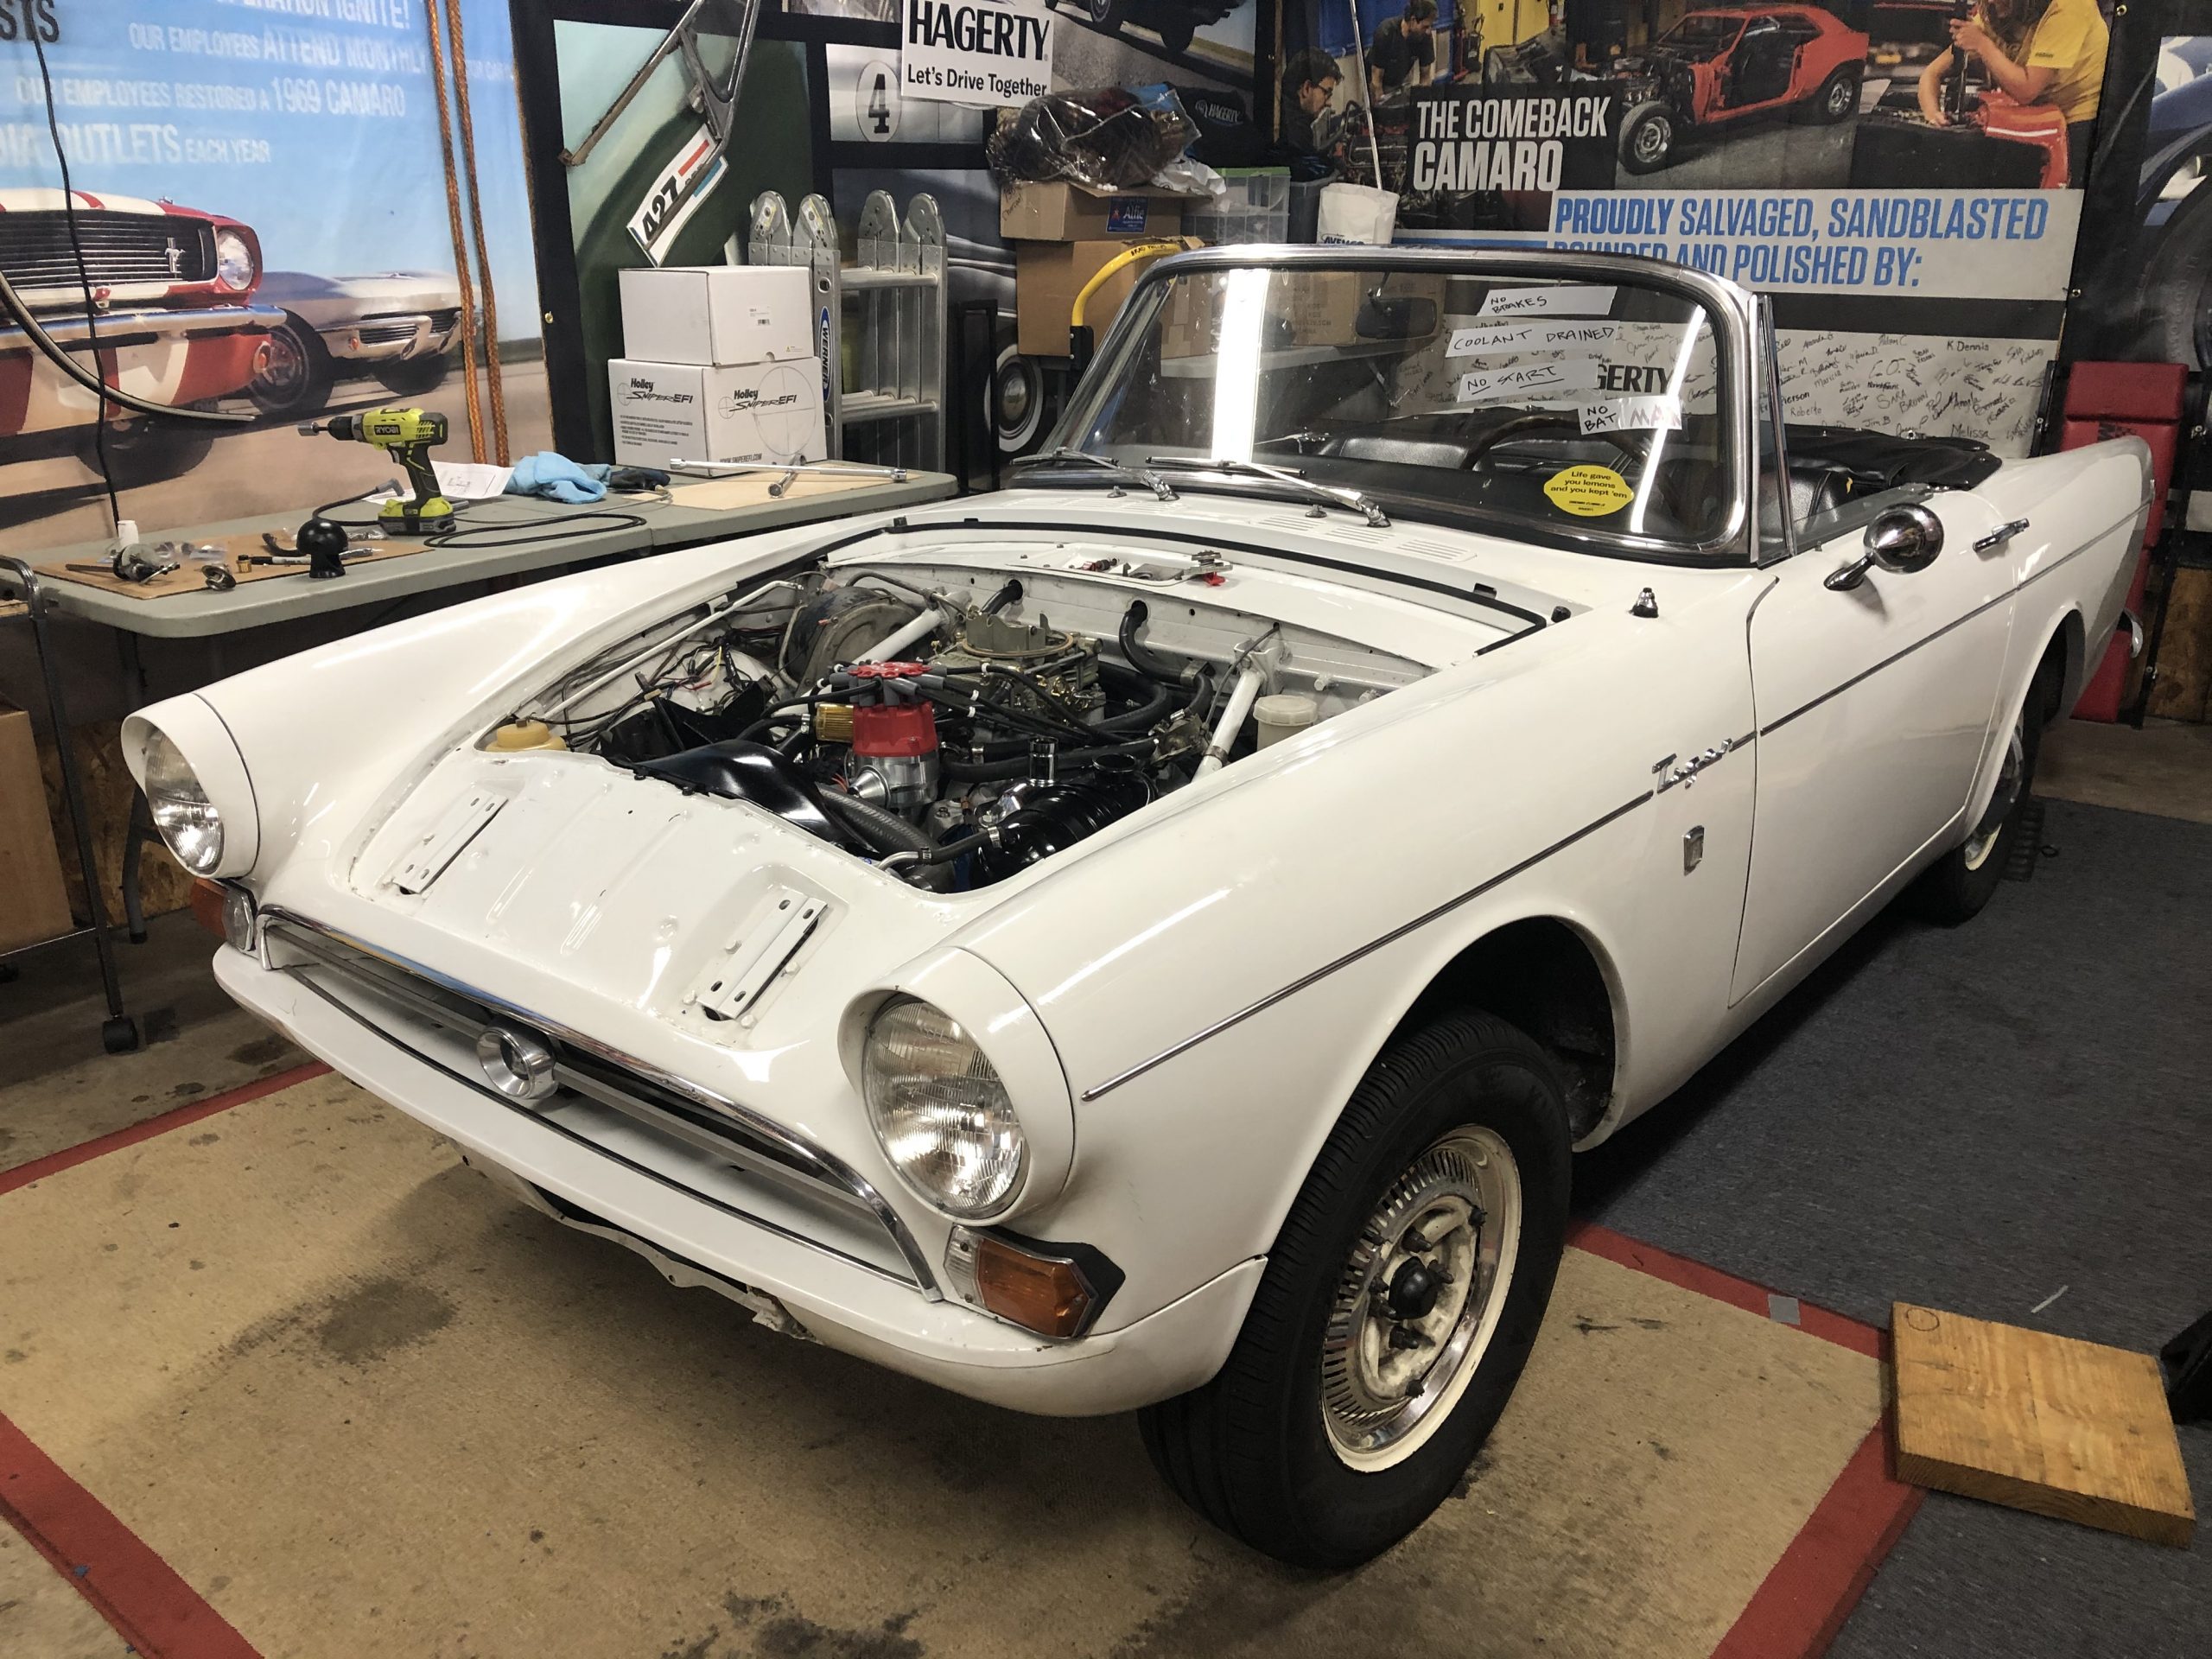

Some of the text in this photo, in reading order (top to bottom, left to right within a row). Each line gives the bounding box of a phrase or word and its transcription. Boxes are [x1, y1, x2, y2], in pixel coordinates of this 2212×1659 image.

[909, 0, 1050, 60] HAGERTY
[129, 22, 166, 50] OUR
[168, 26, 260, 59] EMPLOYEES
[263, 25, 340, 67] ATTEND
[907, 63, 1047, 98] Let's Drive Together
[62, 78, 171, 107] EMPLOYEES
[175, 82, 257, 111] RESTORED
[271, 76, 321, 113] 1969
[326, 79, 406, 118] CAMARO
[868, 73, 891, 135] 4
[1415, 96, 1611, 139] THE COMEBACK
[54, 123, 181, 165] OUTLETS
[185, 138, 230, 162] EACH
[232, 138, 271, 163] YEAR
[1413, 140, 1564, 192] CAMARO
[1555, 198, 2049, 244] PROUDLY SALVAGED, SANDBLASTED
[1732, 245, 1869, 285] POLISHED
[1873, 245, 1923, 287] BY:
[1491, 296, 1506, 305] NO
[1492, 296, 1548, 315] BRAKES
[1454, 329, 1533, 351] COOLANT
[1546, 327, 1615, 344] DRAINED
[1947, 340, 1990, 353] K Dennis
[821, 325, 830, 390] WERNER
[631, 378, 654, 393] Holley
[1467, 366, 1559, 391] NO START
[734, 389, 760, 400] Holley
[1587, 406, 1609, 416] NO
[1790, 400, 1822, 417] Roberto
[375, 426, 400, 435] RYOBI
[1584, 412, 1617, 432] BAT
[1951, 423, 1996, 441] Melissa
[1583, 480, 1616, 489] lemons
